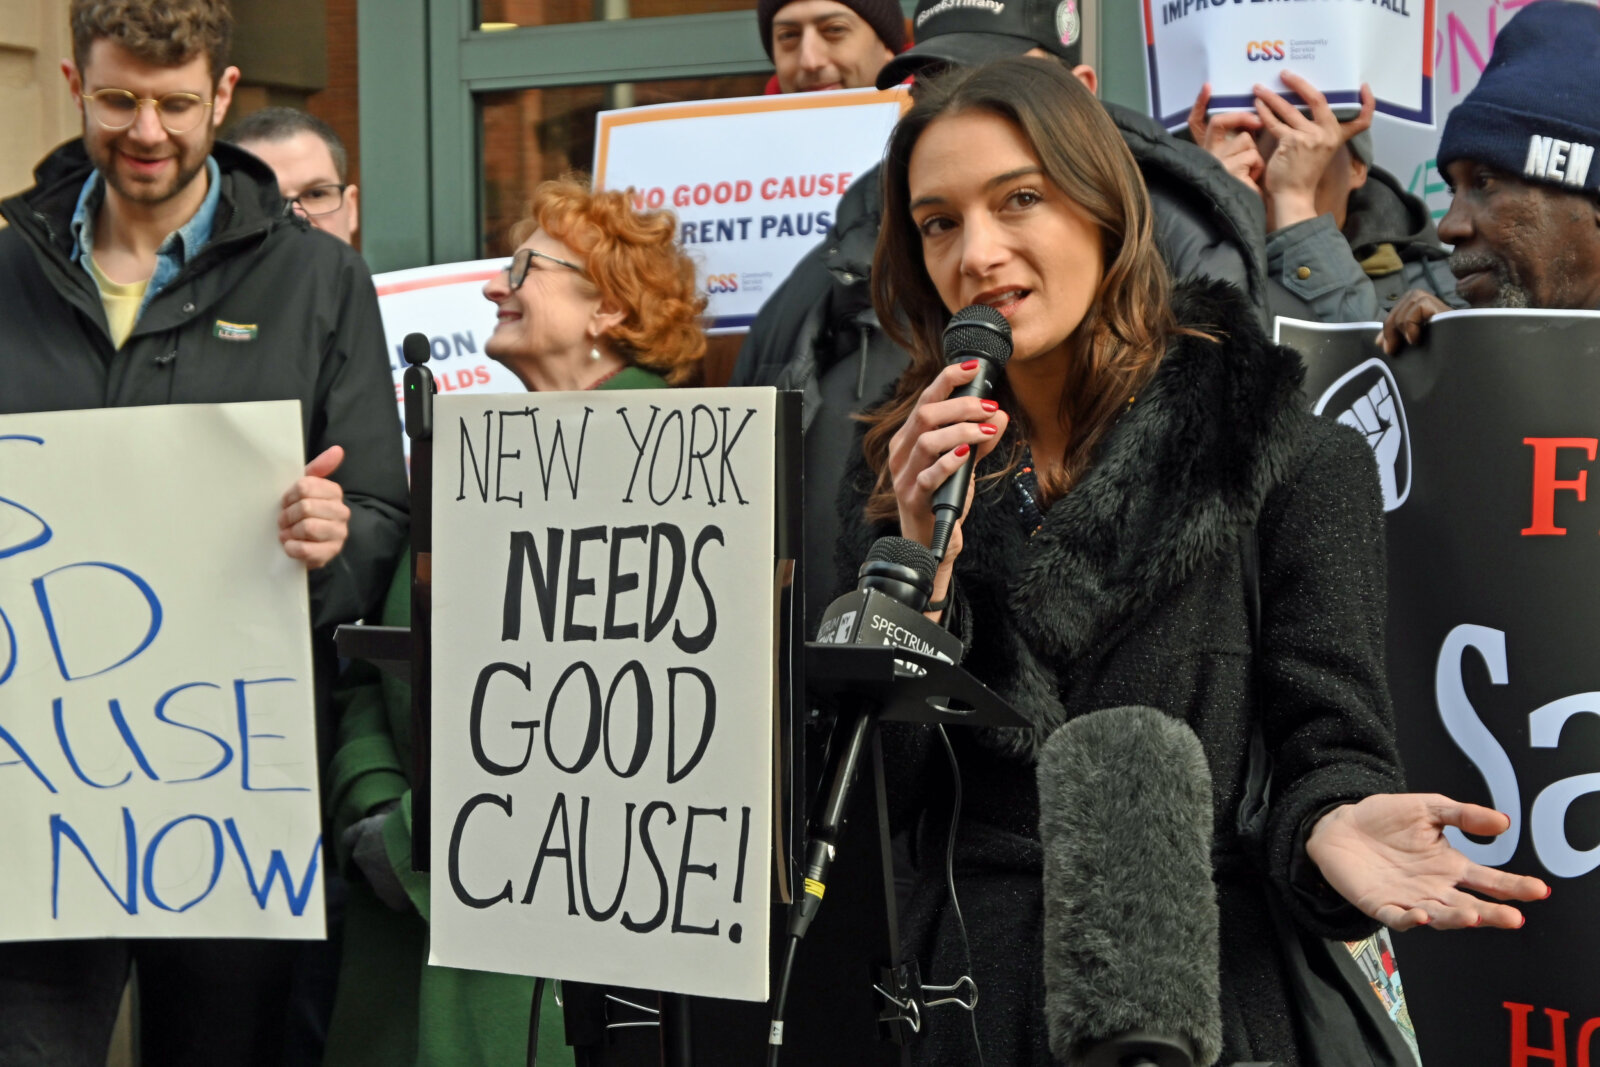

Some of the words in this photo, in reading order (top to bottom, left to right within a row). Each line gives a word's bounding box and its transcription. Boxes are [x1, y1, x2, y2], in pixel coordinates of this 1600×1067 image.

[1247, 40, 1285, 61] CSS
[1524, 134, 1595, 187] NEW
[673, 180, 752, 207] GOOD
[760, 172, 853, 201] CAUSE
[681, 217, 753, 244] RENT
[760, 211, 834, 239] PAUS
[707, 273, 738, 294] CSS
[456, 406, 594, 509] NEW
[616, 404, 757, 507] YORK
[501, 522, 725, 655] NEEDS
[870, 614, 935, 656] SPECTRUM
[469, 659, 717, 784] GOOD
[49, 806, 322, 919] NOW
[447, 792, 752, 943] CAUSE!
